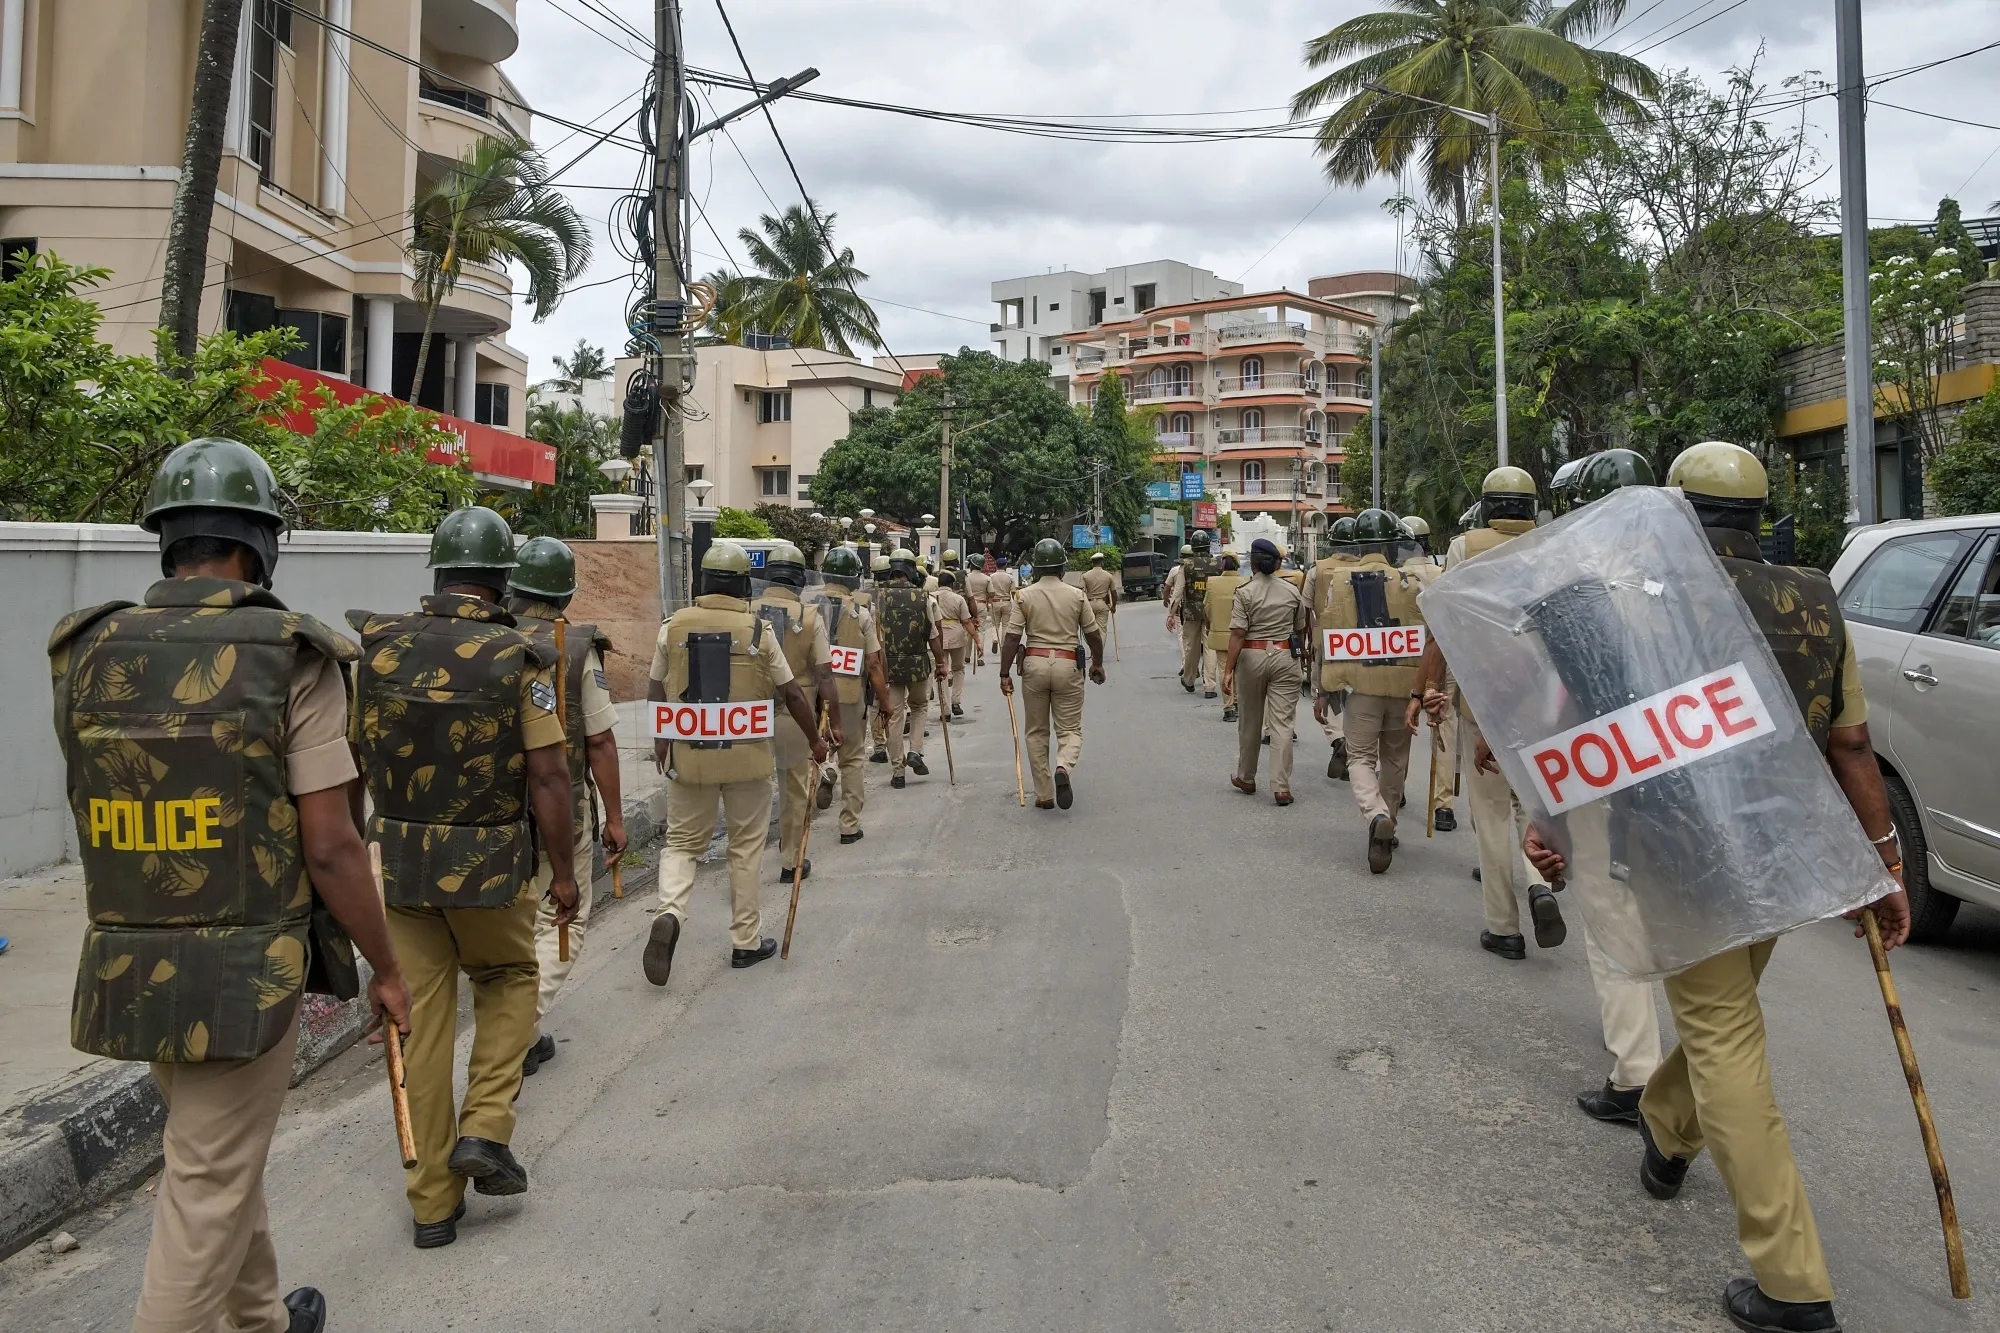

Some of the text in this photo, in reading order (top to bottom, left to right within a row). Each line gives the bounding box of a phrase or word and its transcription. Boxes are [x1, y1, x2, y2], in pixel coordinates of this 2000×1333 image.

[748, 552, 761, 561] UT
[1194, 581, 1207, 590] POL
[1328, 629, 1421, 657] POLICE
[656, 705, 768, 736] POLICE
[1533, 676, 1758, 804] POLICE
[88, 797, 223, 851] POLICE
